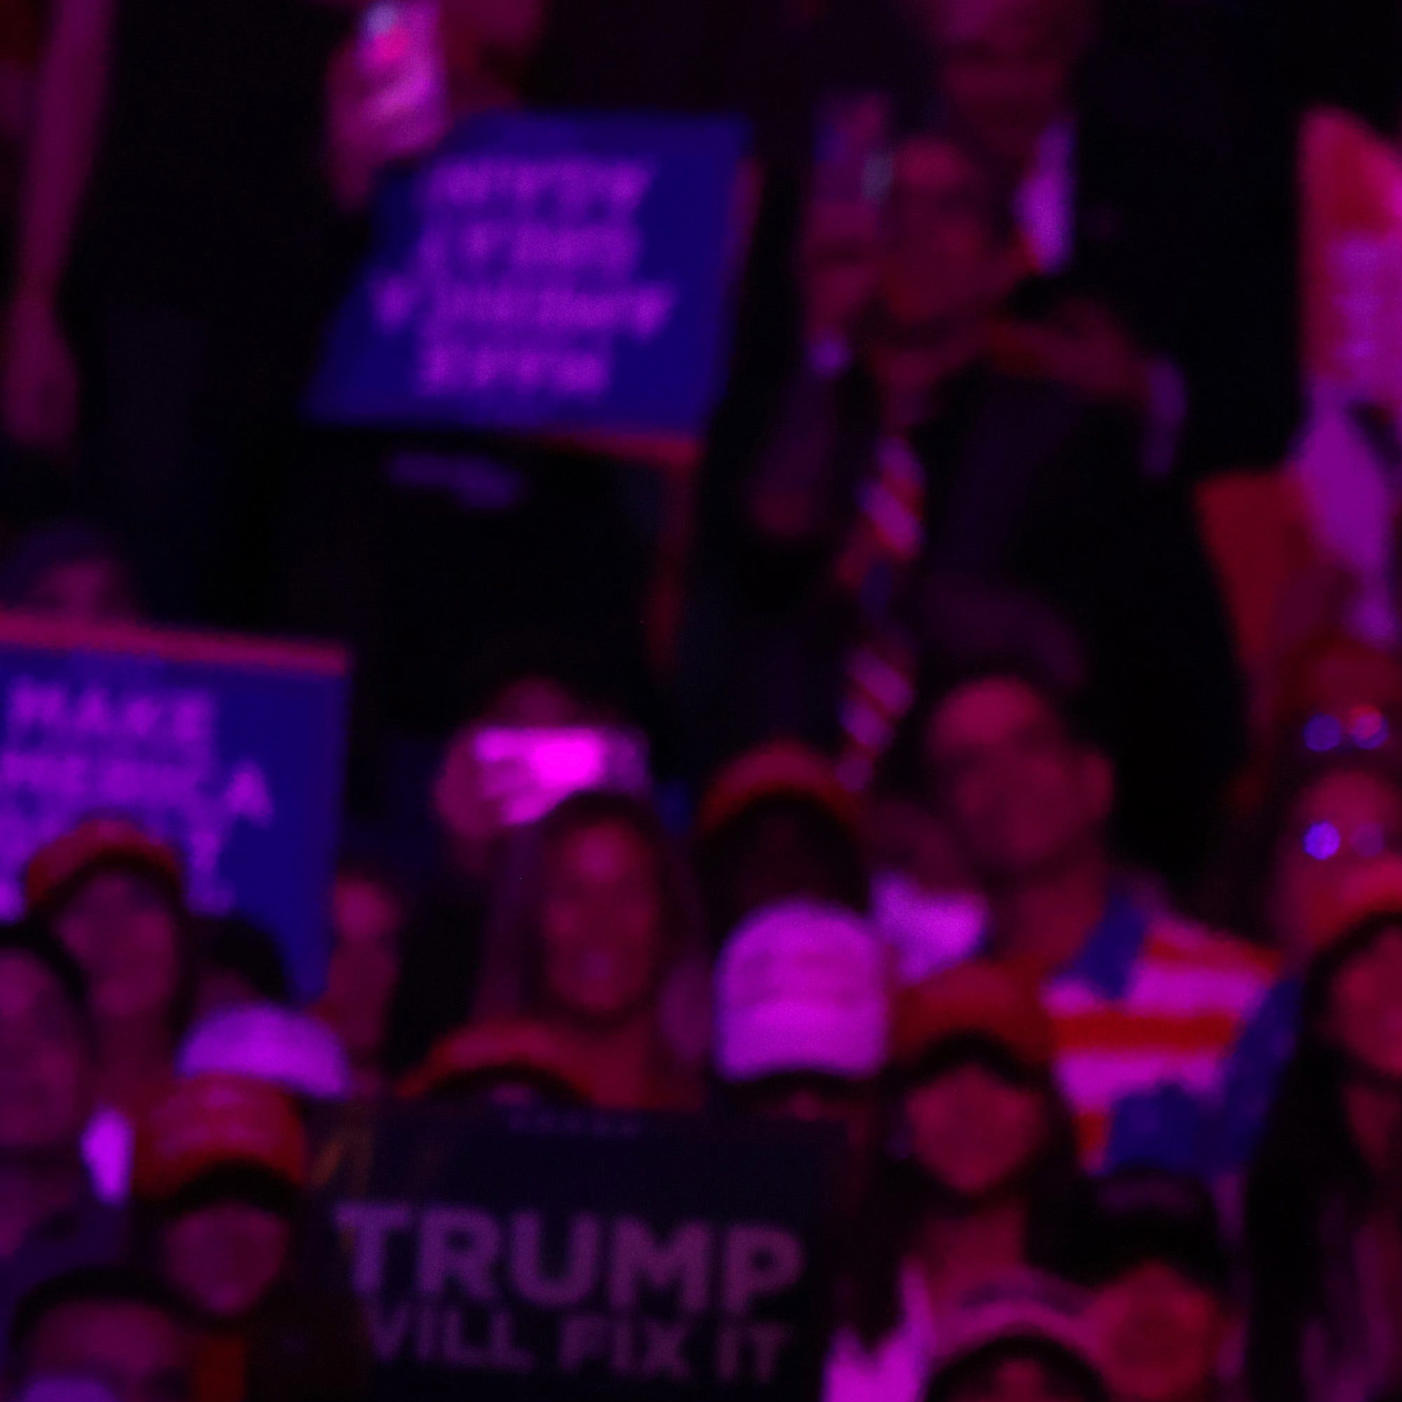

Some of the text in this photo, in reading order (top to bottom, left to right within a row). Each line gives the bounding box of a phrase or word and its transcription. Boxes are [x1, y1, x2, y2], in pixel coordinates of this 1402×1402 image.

[0, 750, 276, 828] MERICA
[334, 1200, 806, 1318] TRUMP
[557, 1312, 696, 1382] FIX
[712, 1318, 792, 1386] IT
